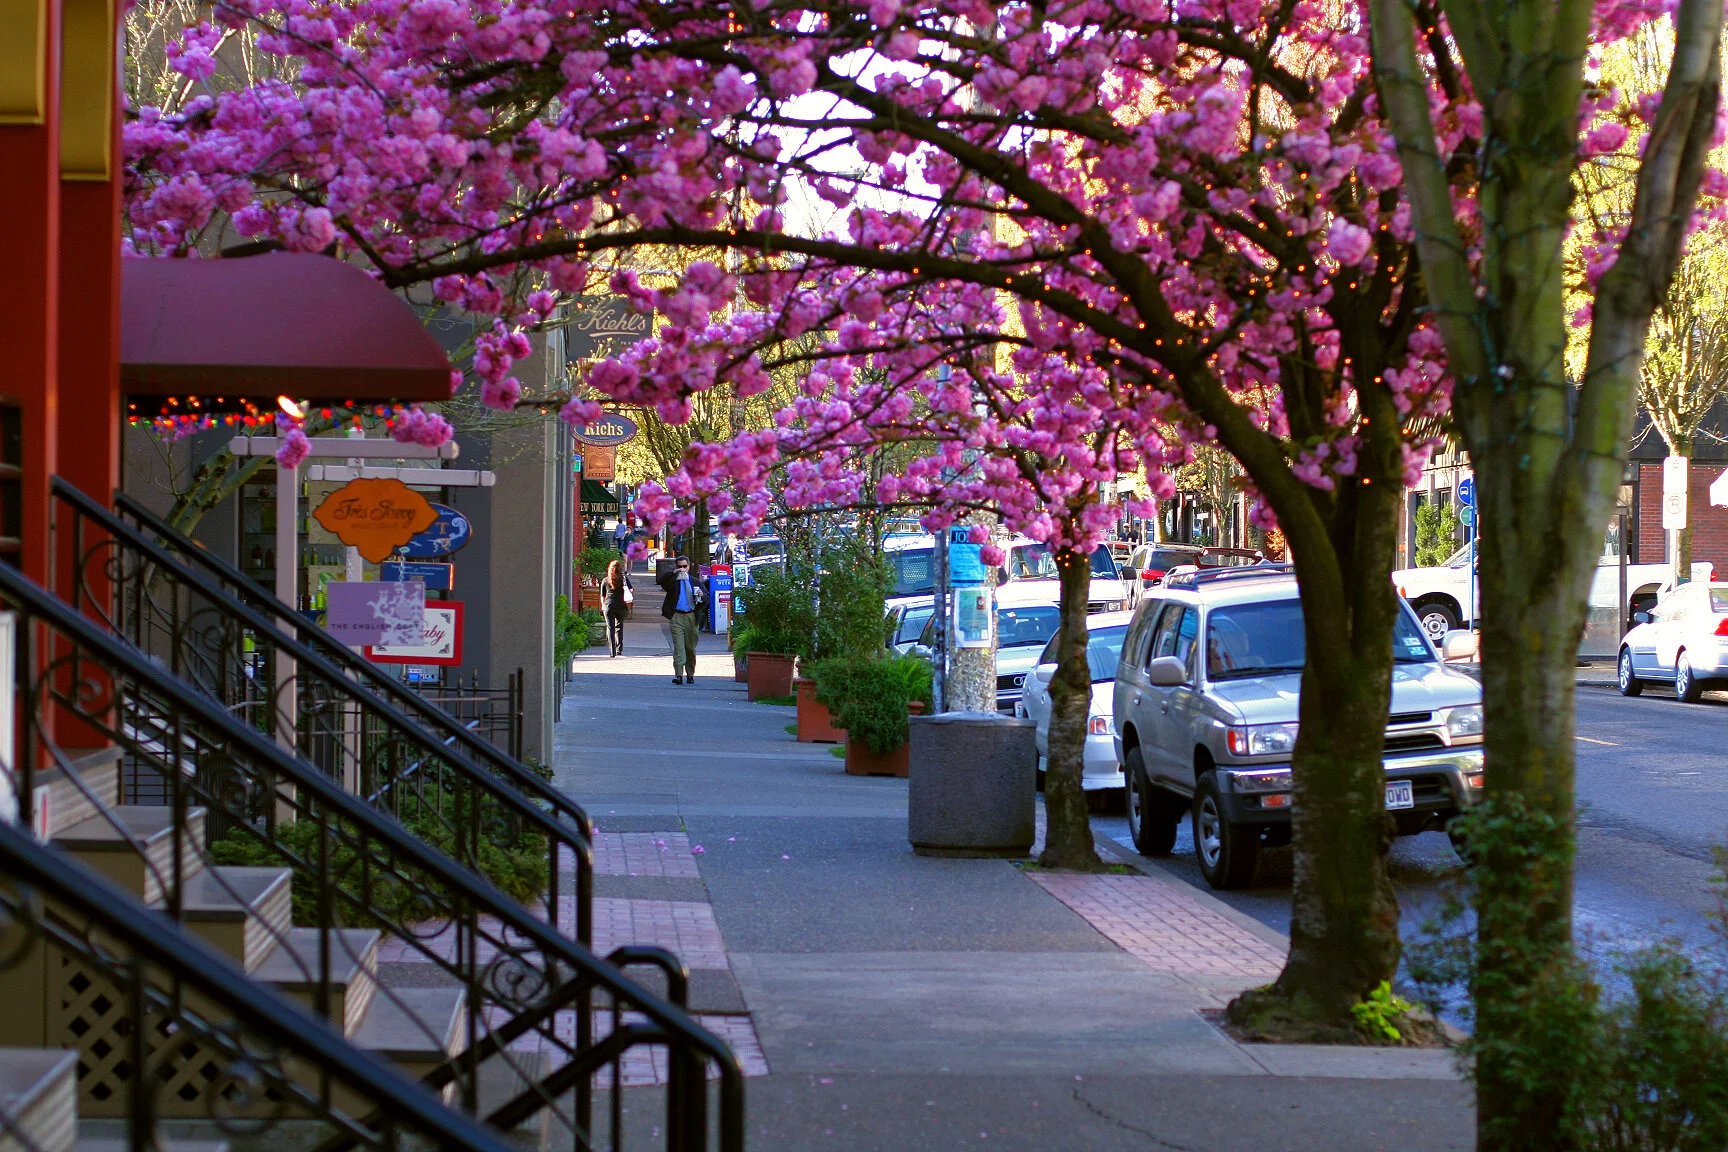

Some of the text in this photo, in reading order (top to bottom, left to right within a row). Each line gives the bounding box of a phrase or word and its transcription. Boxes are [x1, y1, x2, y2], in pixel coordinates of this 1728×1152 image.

[577, 308, 646, 331] Kiehl's
[583, 422, 624, 436] Rich's
[591, 502, 605, 513] YORK
[606, 502, 619, 513] DELI
[423, 622, 446, 646] aby
